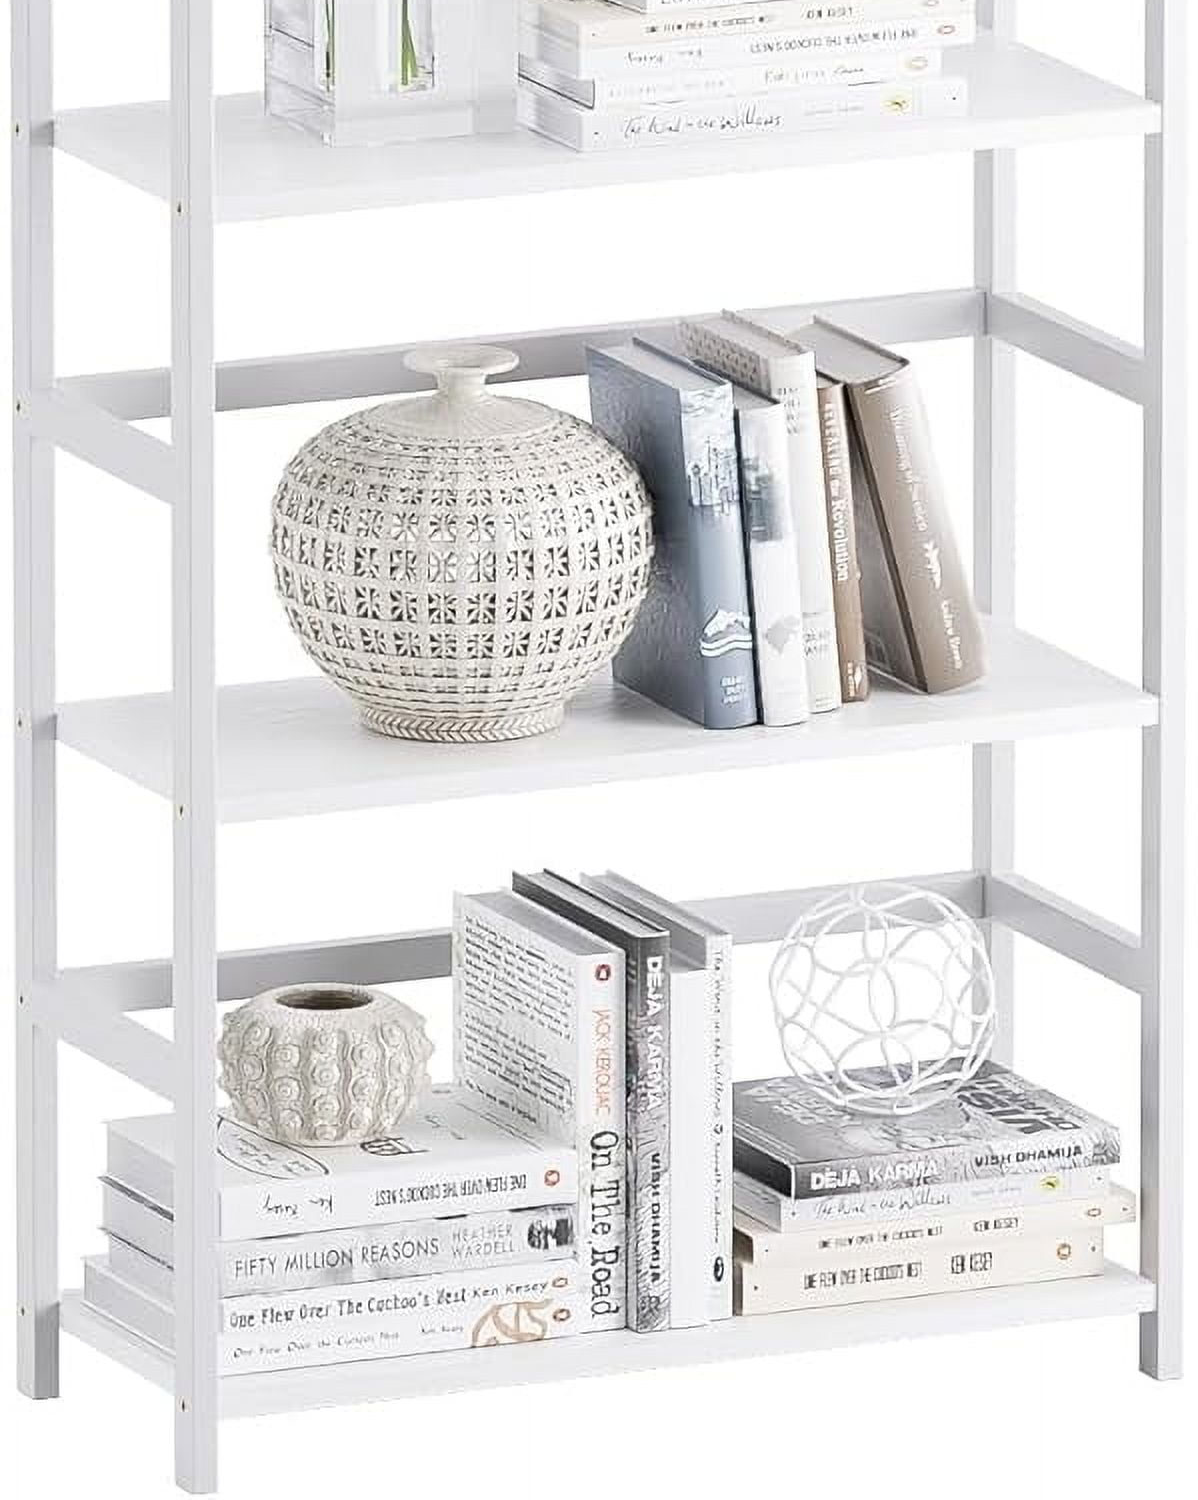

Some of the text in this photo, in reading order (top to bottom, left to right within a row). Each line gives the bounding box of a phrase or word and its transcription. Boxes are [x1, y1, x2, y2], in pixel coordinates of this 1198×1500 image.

[831, 499, 851, 582] Revolution
[593, 1007, 613, 1115] JACK KEROUAC
[868, 1159, 939, 1185] KARMA
[974, 1144, 1084, 1168] VISH DHAMIJA
[590, 1130, 621, 1318] On The Road
[234, 1238, 439, 1279] FIFTY MILLION REASONS
[230, 1310, 255, 1328] One
[261, 1306, 294, 1325] Flew
[338, 1299, 363, 1317] The
[473, 1285, 499, 1299] Ken
[504, 1280, 549, 1297] Kesey
